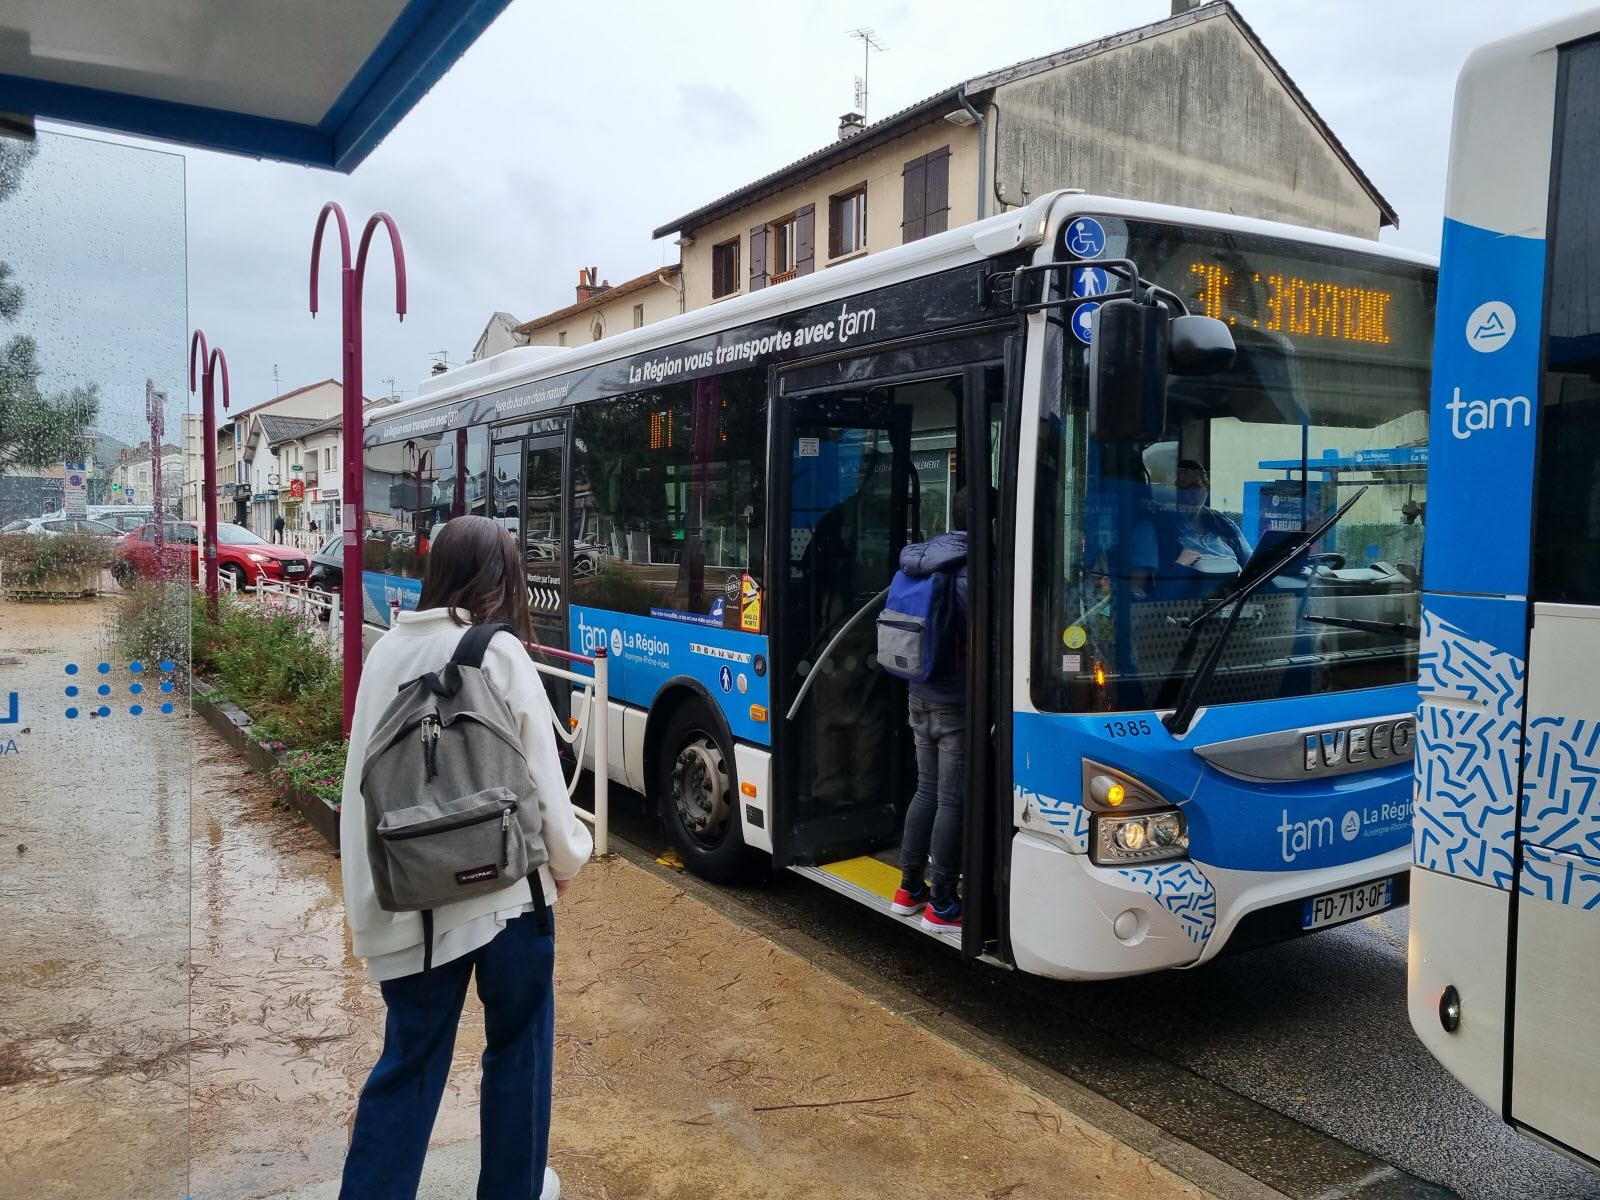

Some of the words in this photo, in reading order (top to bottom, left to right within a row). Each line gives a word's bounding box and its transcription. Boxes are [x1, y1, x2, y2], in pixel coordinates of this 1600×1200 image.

[629, 365, 642, 384] La
[642, 357, 682, 383] Région
[684, 350, 714, 371] vous
[715, 329, 793, 365] transporte
[793, 321, 835, 348] avec
[837, 302, 876, 344] tam
[494, 398, 507, 413] Faire
[513, 396, 523, 410] bus
[531, 389, 547, 405] choix
[546, 381, 570, 402] naturel
[389, 422, 401, 439] Région
[401, 420, 412, 434] vous
[411, 415, 436, 434] transporte
[435, 413, 448, 426] avec
[447, 406, 460, 427] tam
[1445, 386, 1531, 440] tam
[527, 573, 542, 583] Montée
[541, 575, 549, 585] par
[548, 575, 561, 585] l'avant
[725, 580, 742, 593] FRANCE
[744, 613, 758, 621] ANGLES
[578, 612, 607, 656] tam
[624, 631, 634, 649] La
[636, 633, 670, 656] Région
[624, 651, 670, 669] Auvergne-Rhône-Alpes
[690, 643, 751, 663] URBANWAY
[1104, 719, 1151, 738] 1385
[1305, 719, 1416, 771] IVECO
[1363, 807, 1379, 825] La
[1277, 809, 1333, 863] tam
[462, 870, 492, 880] EASTPAK
[1314, 883, 1385, 924] FD-713-QF
